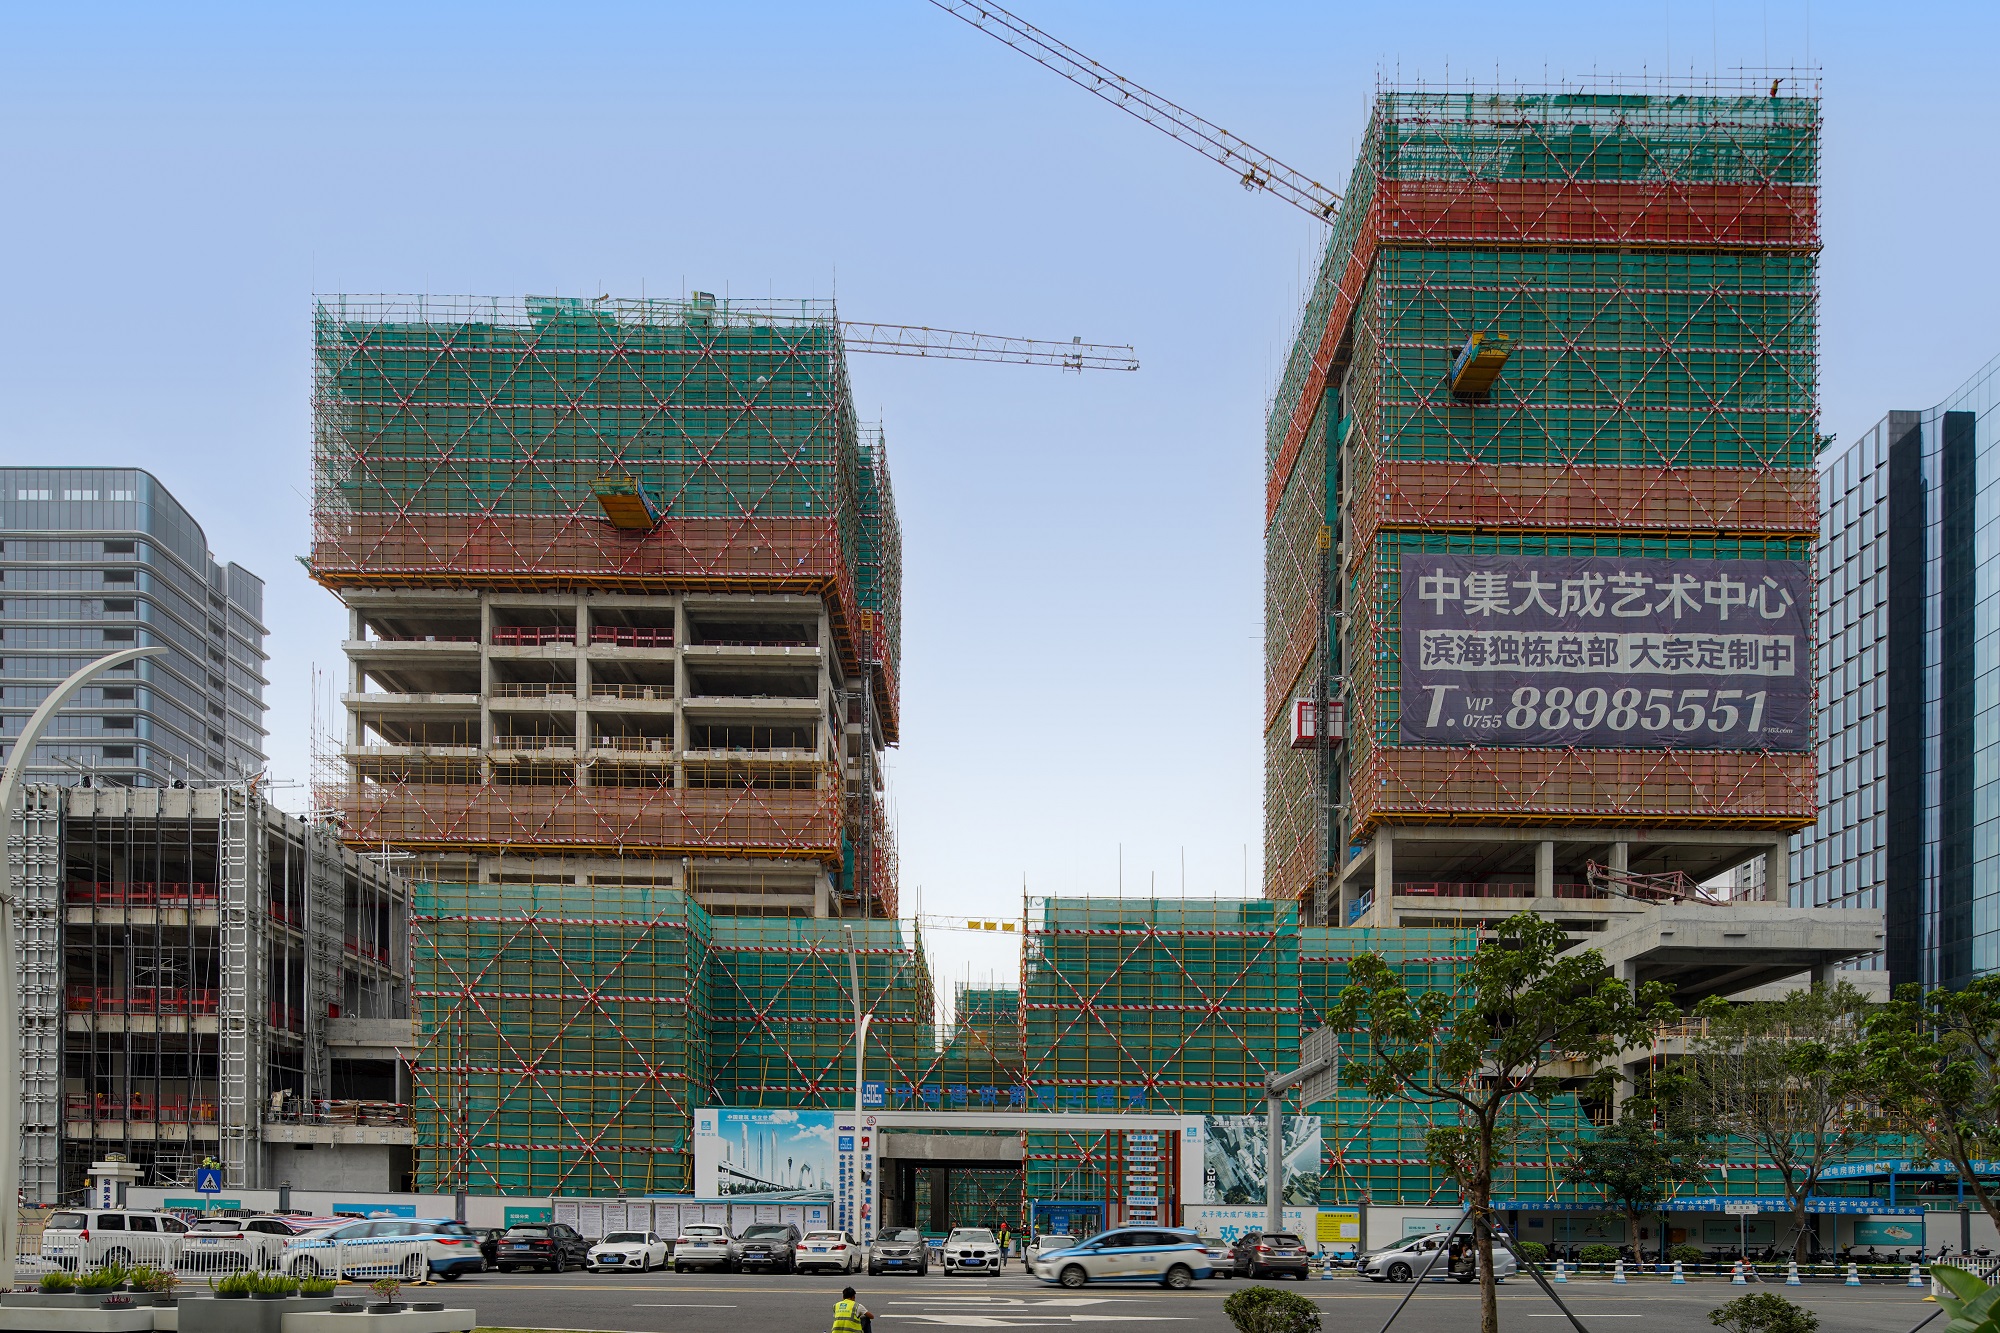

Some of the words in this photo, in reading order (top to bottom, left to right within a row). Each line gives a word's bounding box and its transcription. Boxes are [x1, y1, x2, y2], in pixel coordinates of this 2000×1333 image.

[1418, 568, 1794, 621] 中集大成艺术中心
[1422, 633, 1619, 669] 滨海独栋总部
[1629, 637, 1792, 671] 大宗定制中
[1422, 685, 1460, 728] T.
[1462, 713, 1503, 729] 0755
[1505, 686, 1767, 733] 88985551
[1465, 696, 1494, 711] VIP
